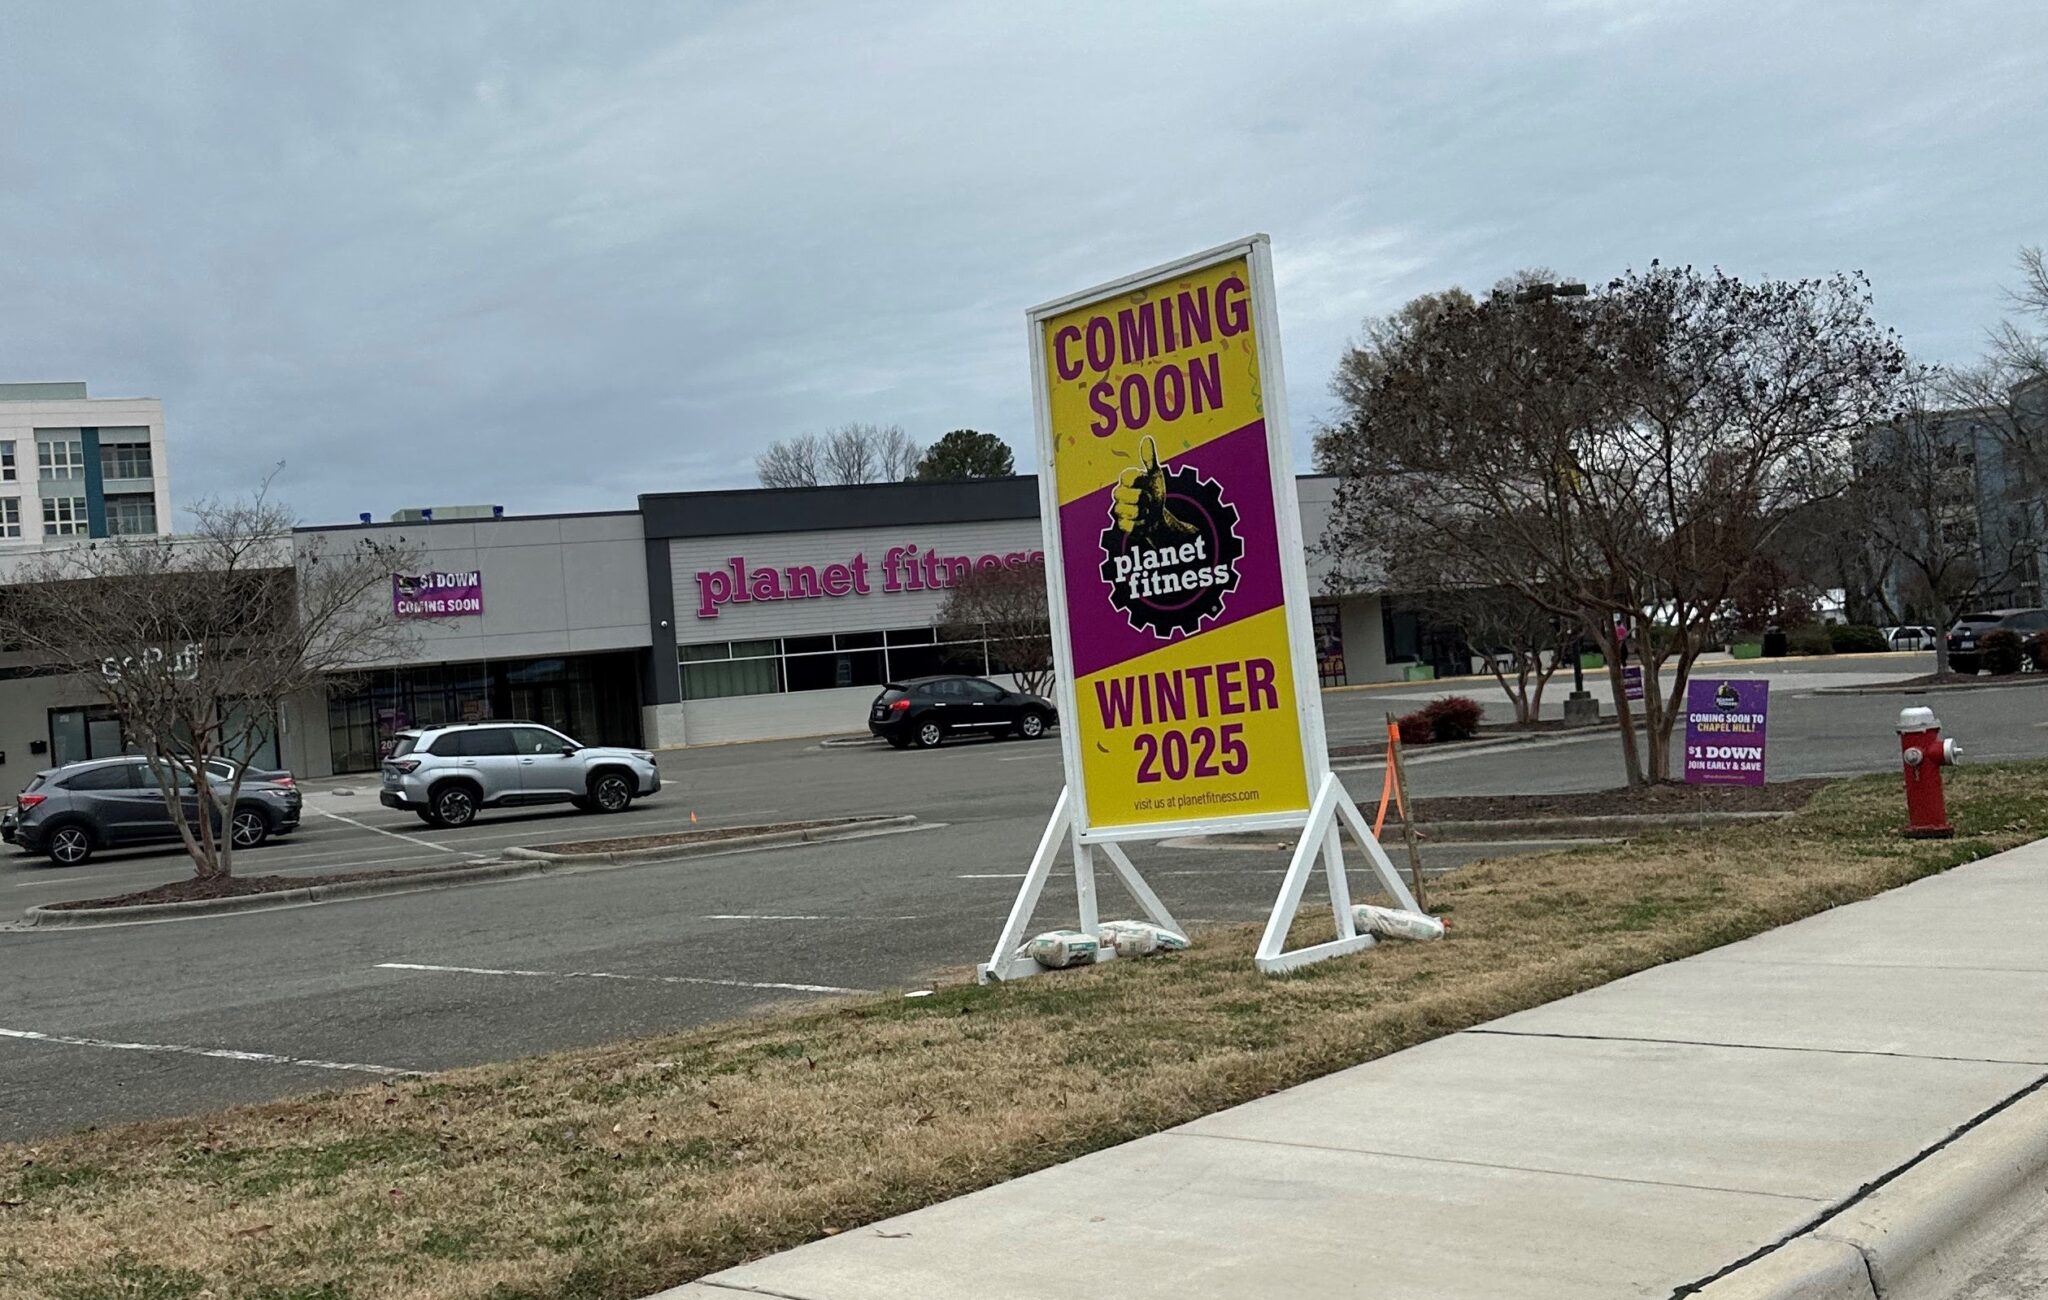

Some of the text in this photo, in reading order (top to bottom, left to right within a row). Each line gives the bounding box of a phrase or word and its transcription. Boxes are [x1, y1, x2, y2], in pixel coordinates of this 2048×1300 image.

[1055, 276, 1250, 381] COMING
[1088, 352, 1224, 438] SOON
[1113, 534, 1207, 583] planet
[436, 572, 478, 588] DOWN
[695, 543, 1045, 618] planet fitnes
[1128, 563, 1230, 600] fitness
[447, 598, 480, 611] SOON
[1094, 657, 1279, 730] WINTER
[1689, 713, 1764, 724] COMING SOON TO
[1697, 723, 1755, 733] CHAPEL HILL!
[1133, 722, 1249, 784] 2025
[1688, 746, 1762, 760] $1 DOWN
[1688, 760, 1761, 771] JOIN EARLY & SAVE
[1134, 789, 1260, 811] visit us at planetfitness.com
